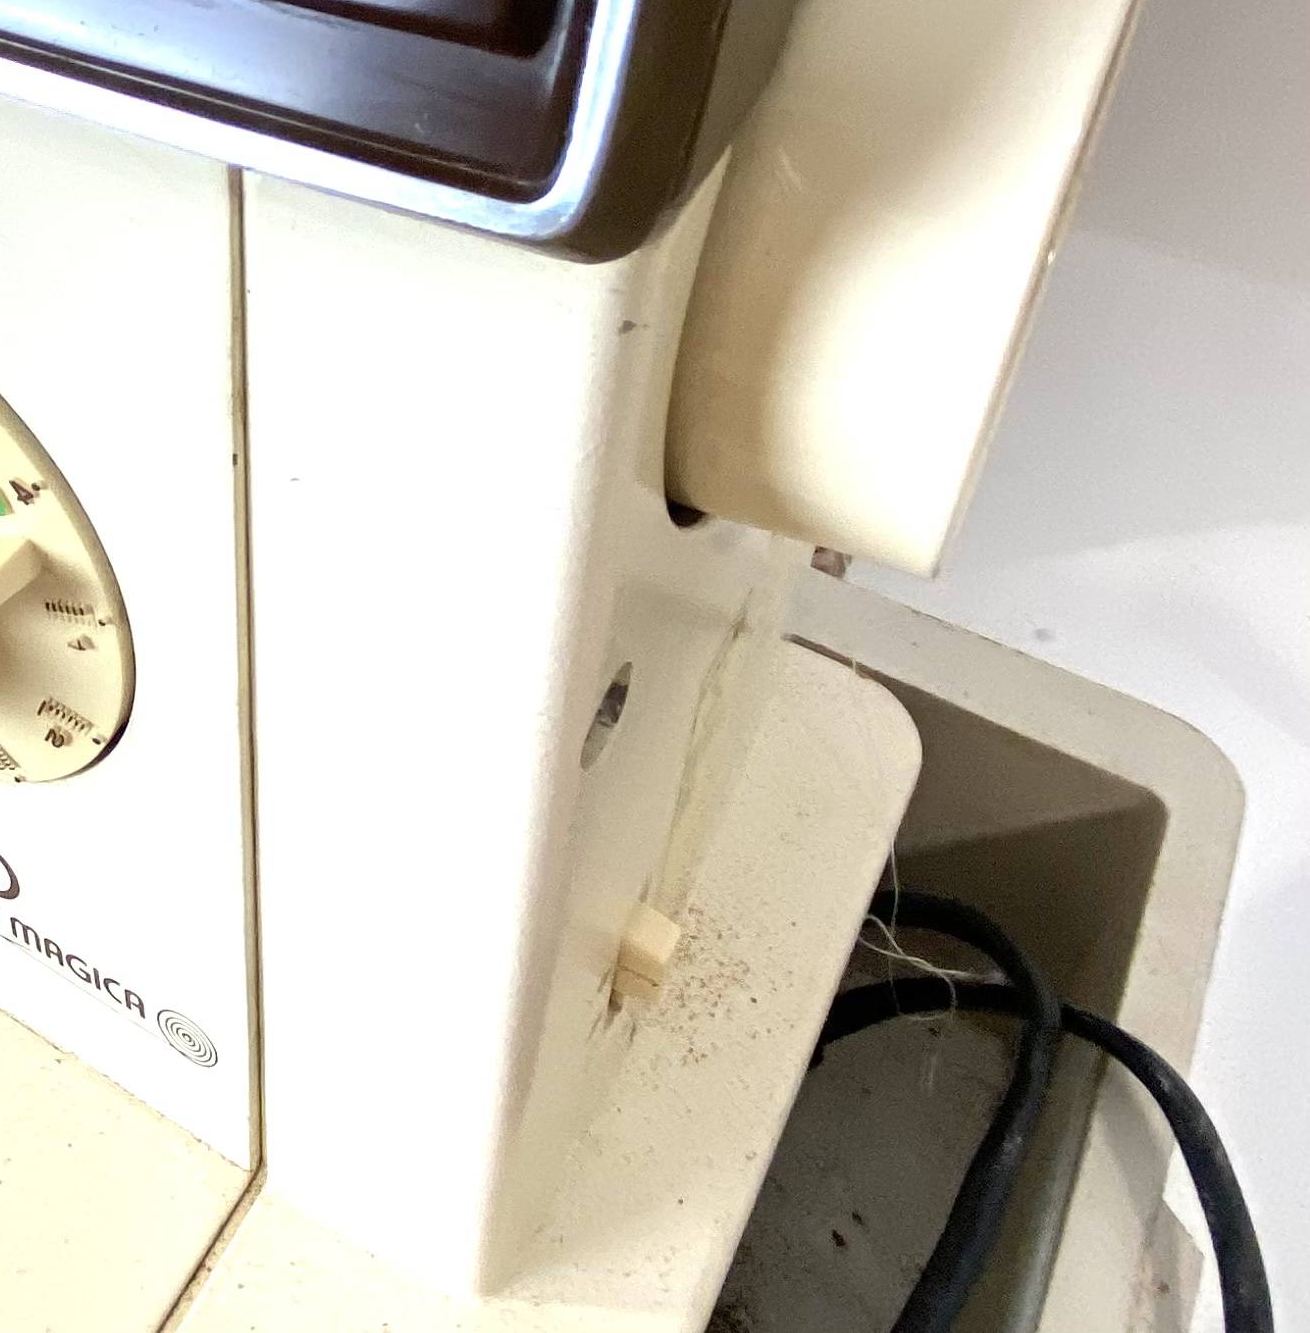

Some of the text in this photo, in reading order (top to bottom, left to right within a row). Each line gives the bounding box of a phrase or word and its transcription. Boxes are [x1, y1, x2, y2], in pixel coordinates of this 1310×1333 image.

[8, 478, 35, 506] 4
[44, 728, 70, 749] 2
[9, 916, 147, 1020] MAGICA
